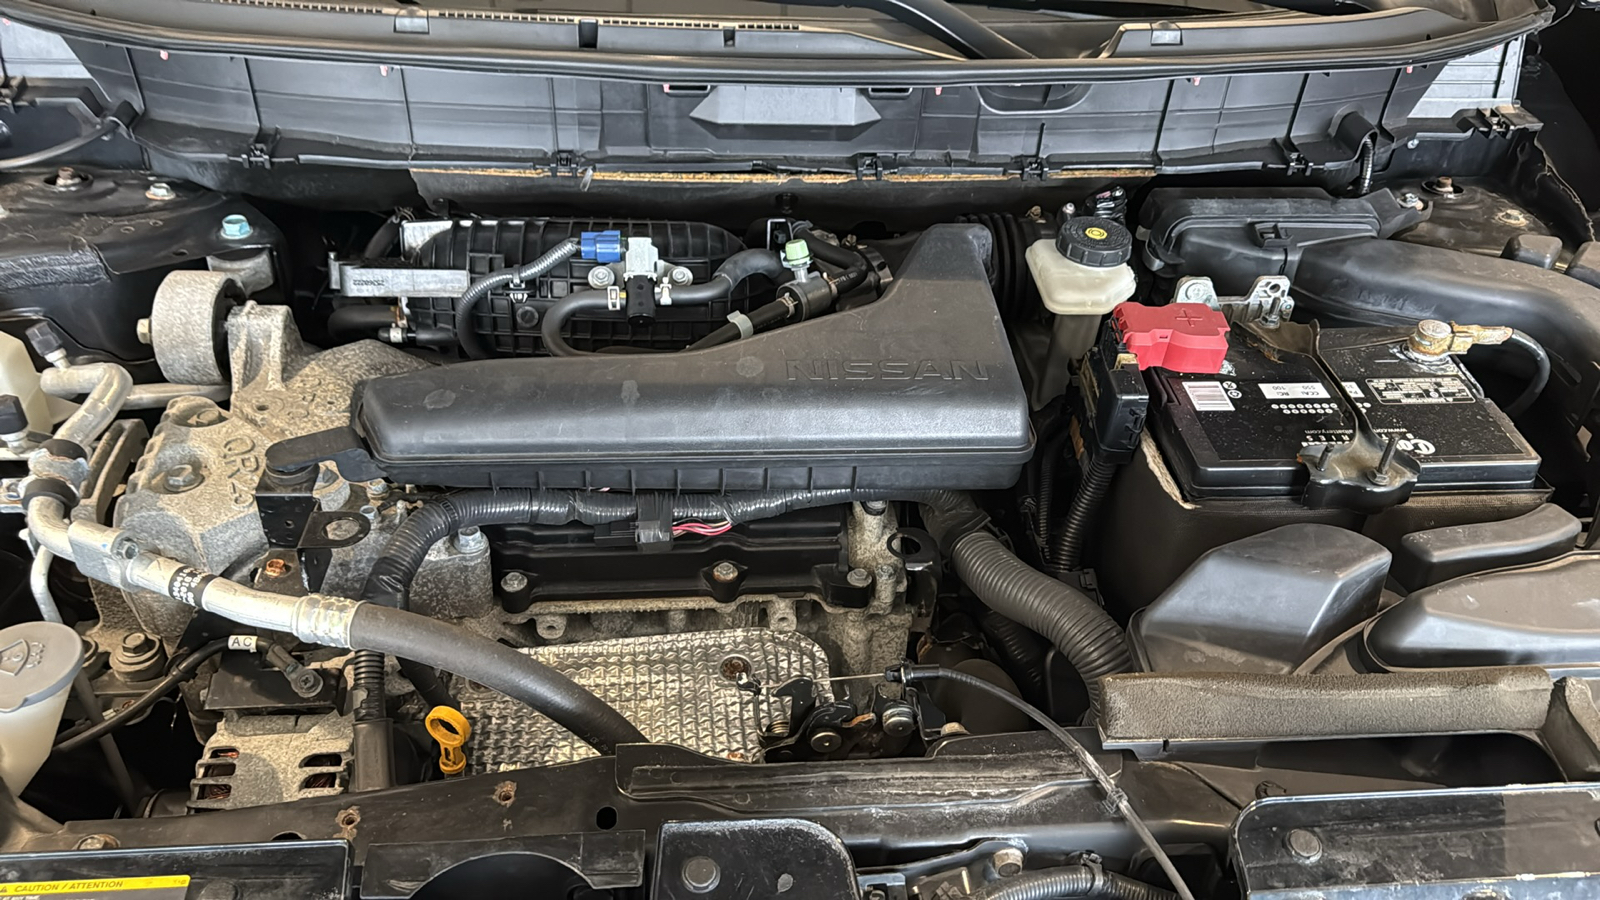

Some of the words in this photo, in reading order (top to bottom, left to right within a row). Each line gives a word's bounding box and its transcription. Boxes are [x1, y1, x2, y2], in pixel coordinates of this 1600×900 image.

[785, 358, 989, 381] NISSAN
[14, 884, 59, 893] CAUTION
[68, 880, 124, 890] ATTENTION
